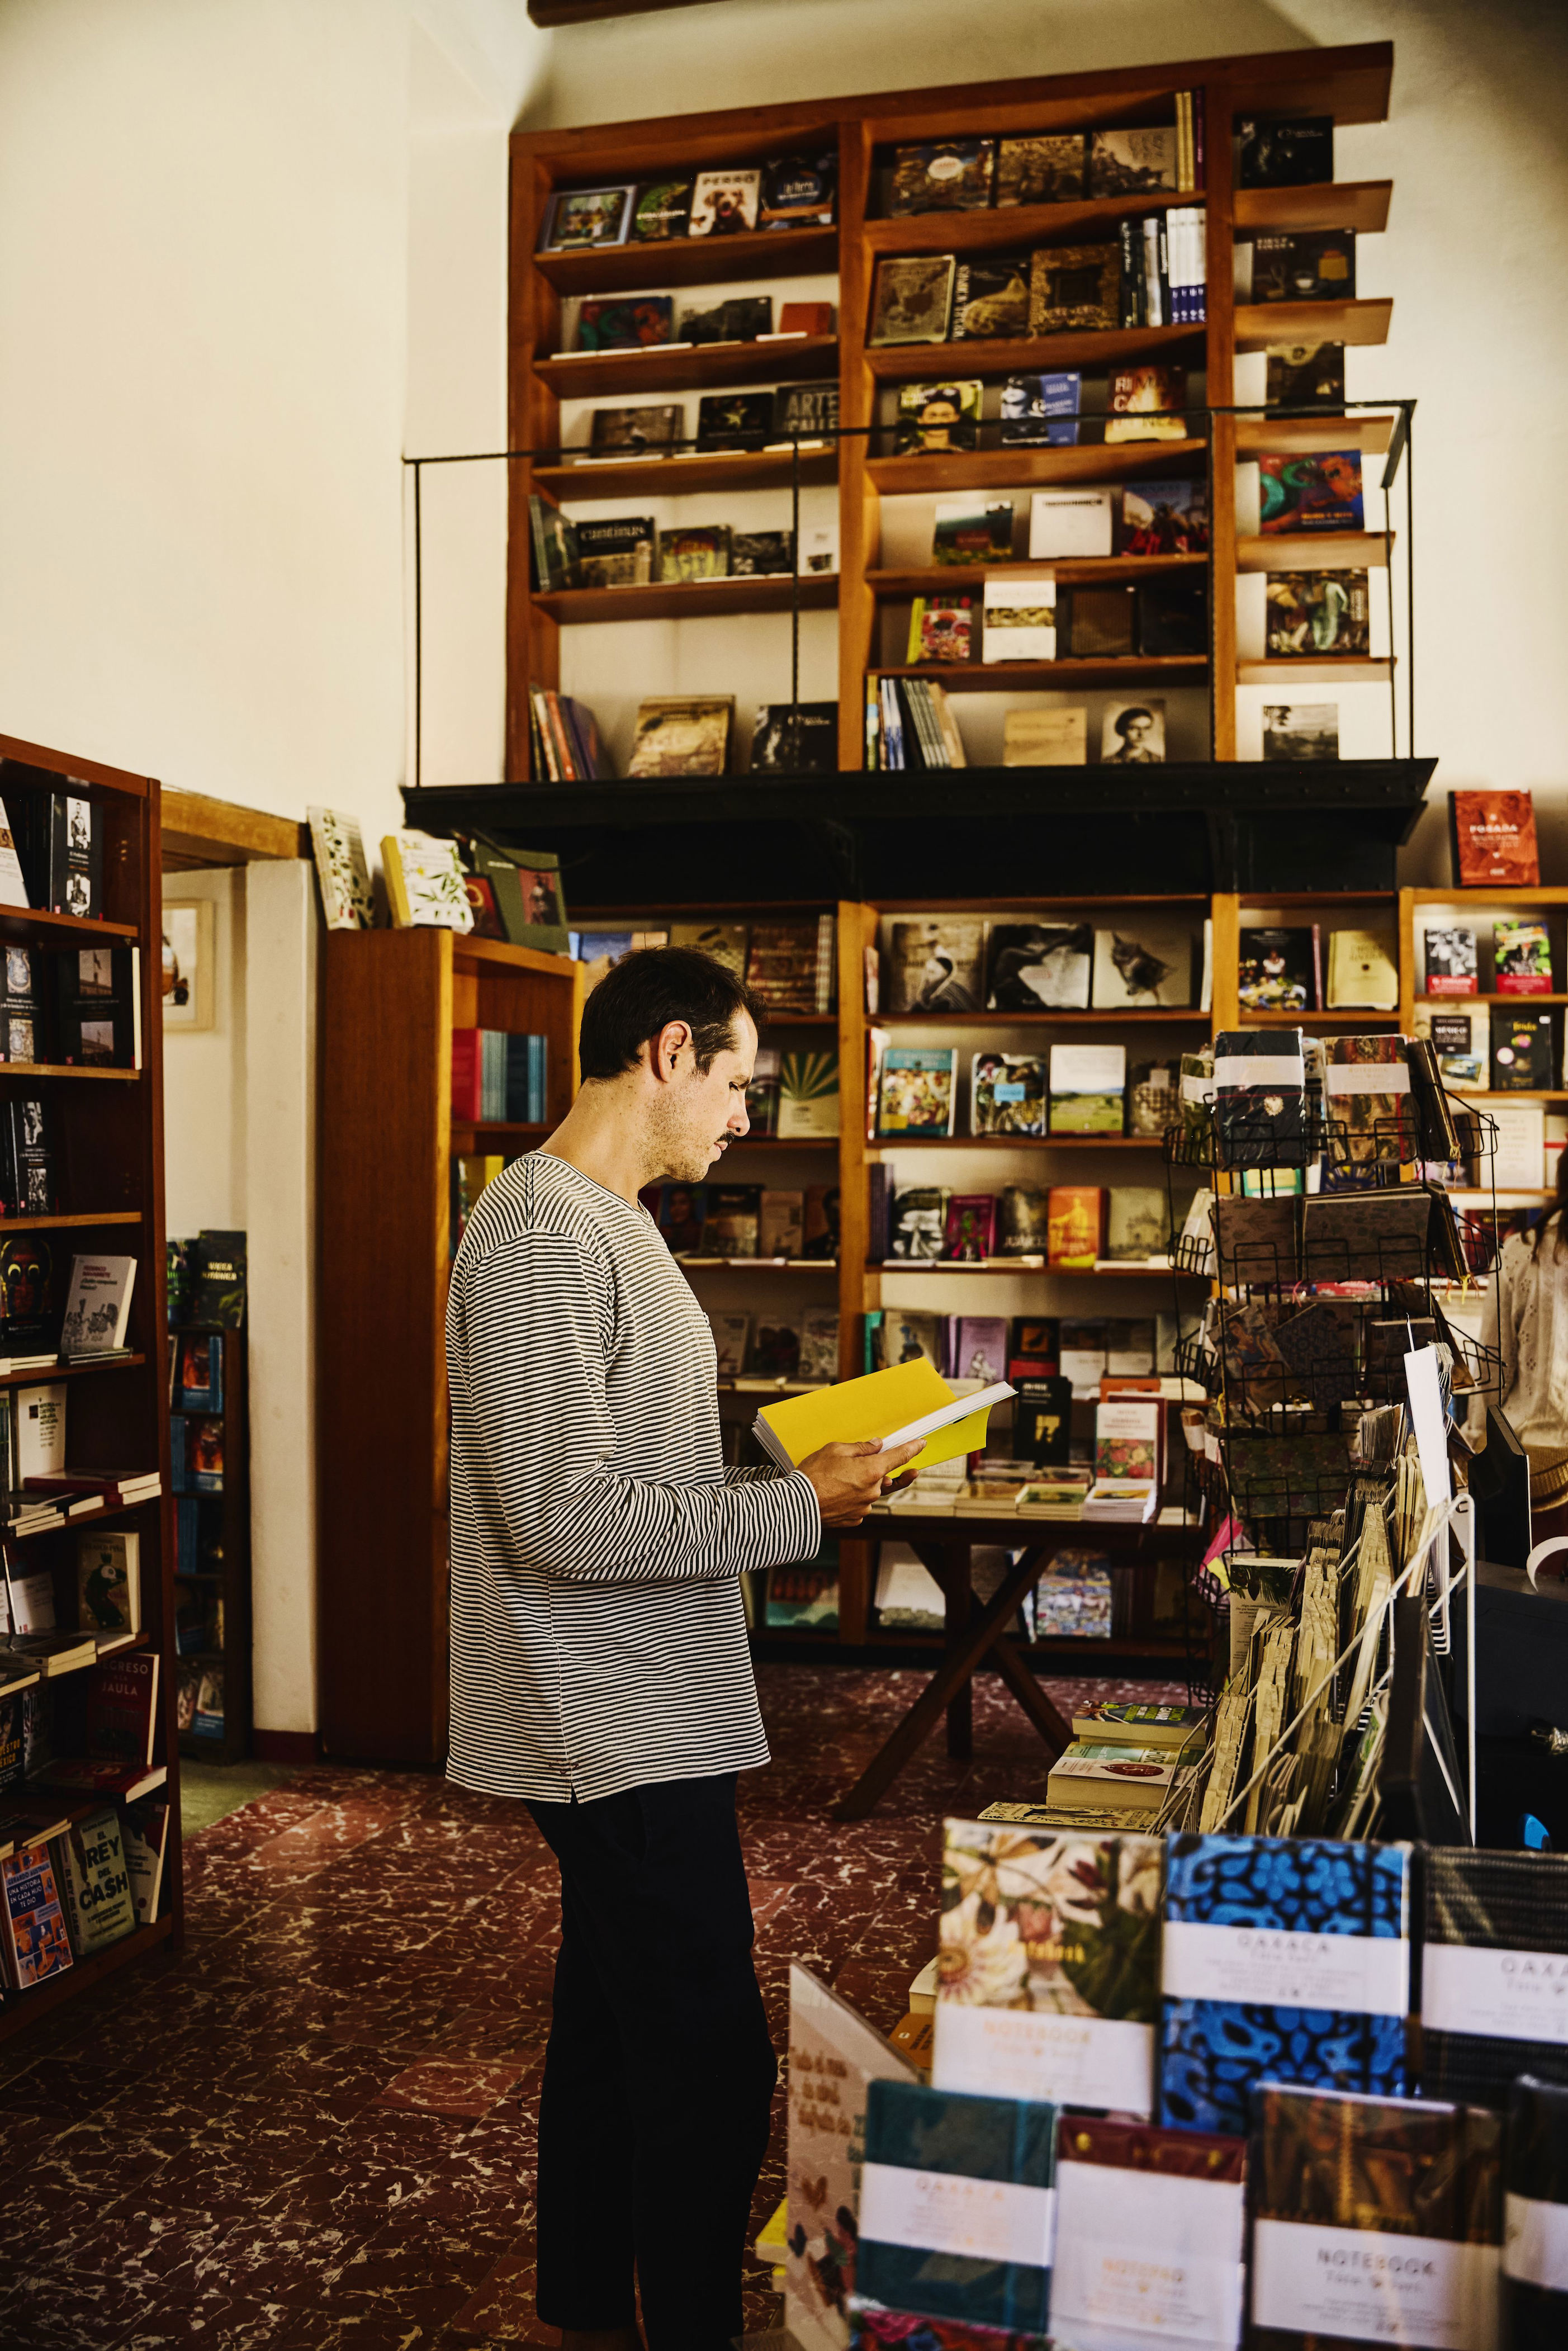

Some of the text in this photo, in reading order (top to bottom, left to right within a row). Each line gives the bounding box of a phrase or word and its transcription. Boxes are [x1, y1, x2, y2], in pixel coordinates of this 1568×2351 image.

[787, 391, 839, 418] ARTE
[1470, 824, 1518, 834] POSADA
[102, 1682, 138, 1696] JAULA
[97, 1831, 107, 1841] EL
[85, 1835, 120, 1868] REY
[97, 1867, 111, 1879] DEL
[8, 1878, 41, 1895] UNA HISTORIA
[17, 1891, 31, 1900] CADA
[31, 1885, 42, 1894] HIJO
[27, 1896, 36, 1905] DIO
[1237, 1931, 1331, 1953] OAXACA
[984, 2020, 1092, 2043] NOTEBOOK
[915, 2174, 1005, 2202] OAXACA
[1102, 2257, 1187, 2282] NOTEPAD
[1317, 2248, 1436, 2276] NOTEBOOK
